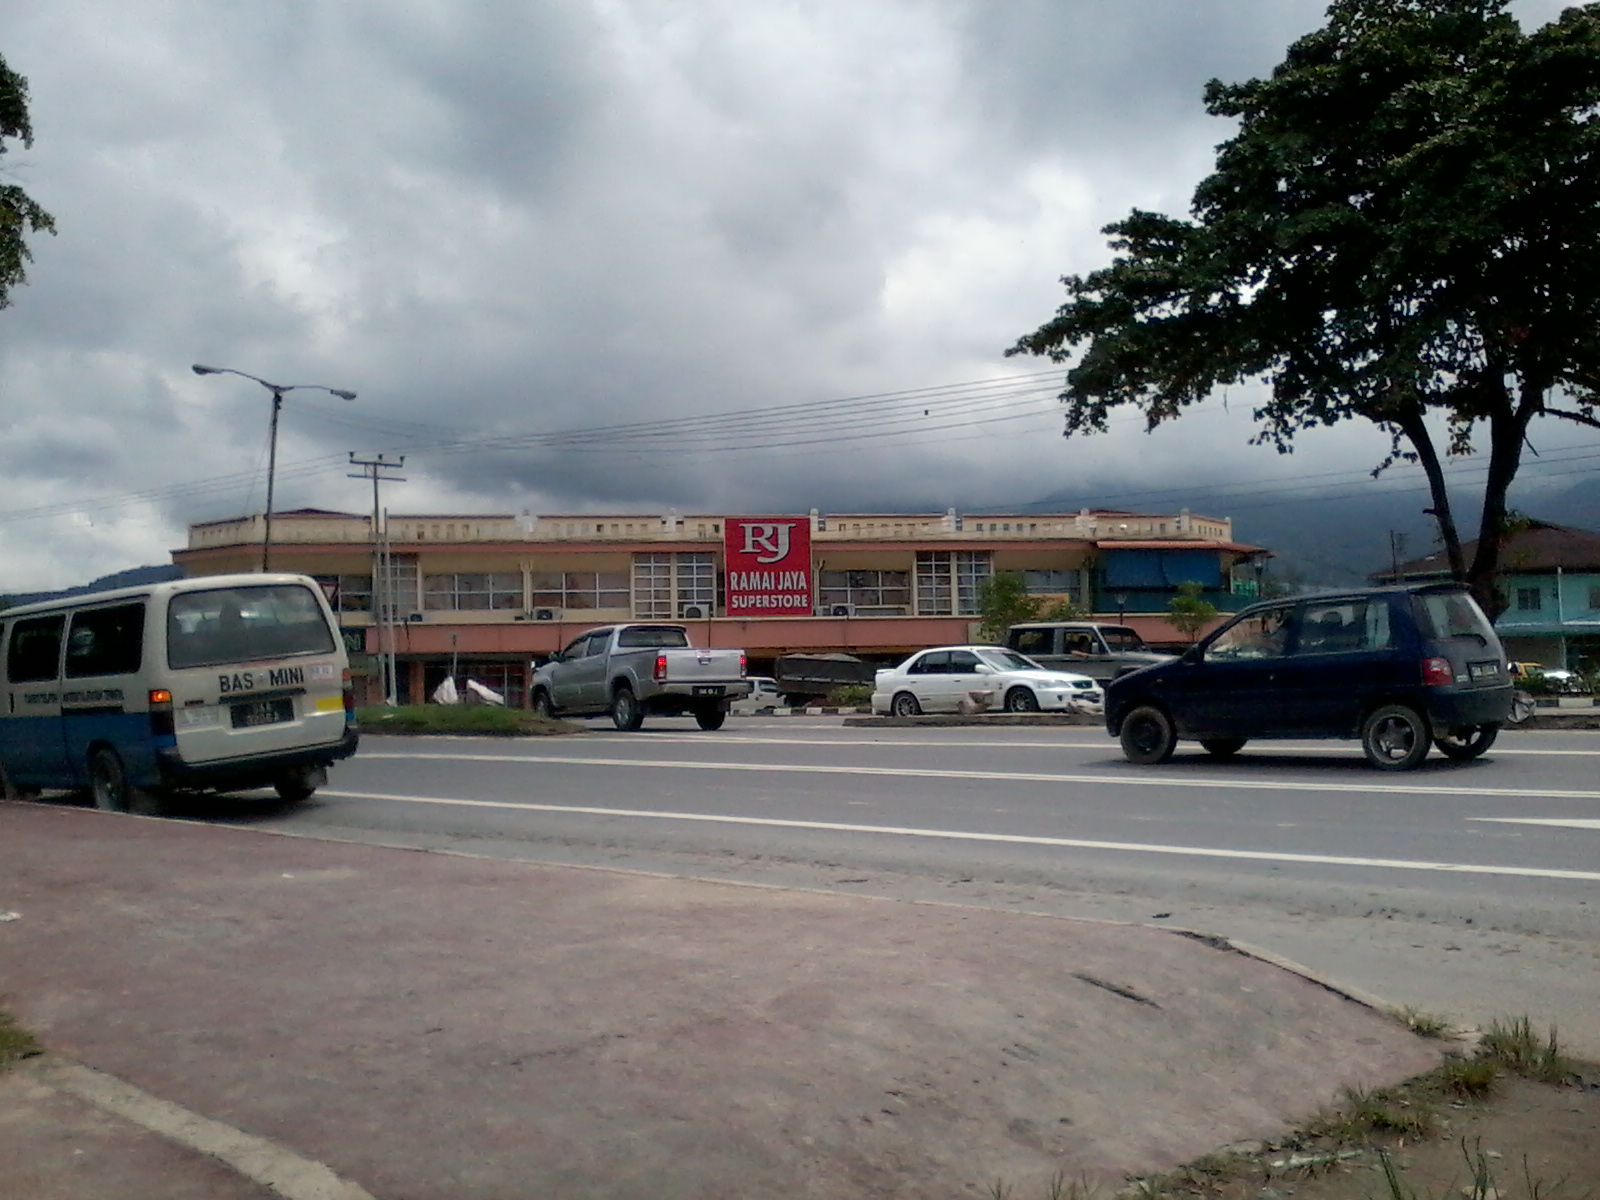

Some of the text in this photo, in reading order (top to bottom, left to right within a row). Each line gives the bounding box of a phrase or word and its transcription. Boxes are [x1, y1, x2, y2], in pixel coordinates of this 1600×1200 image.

[739, 523, 797, 564] RJ
[730, 571, 807, 591] RAMAI JAYA
[731, 594, 808, 608] SUPERSTORE
[218, 673, 254, 693] BAS
[269, 667, 304, 686] MINI
